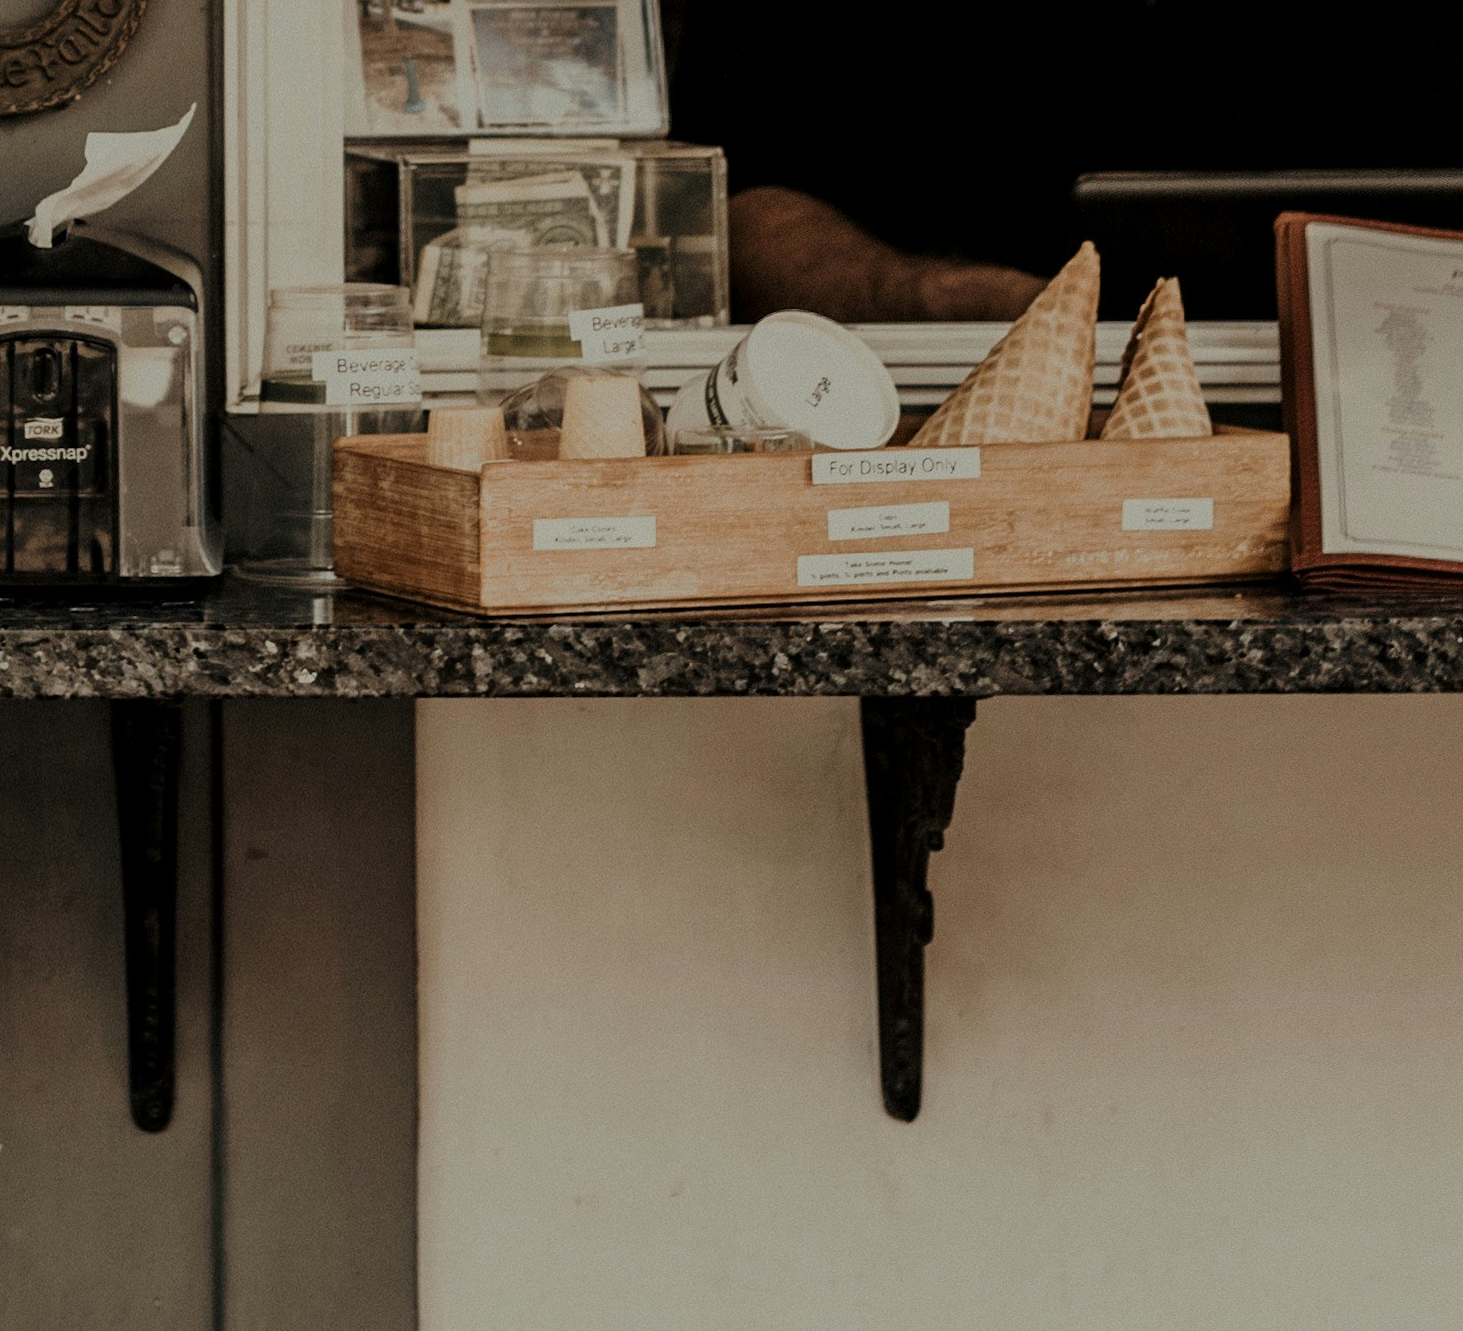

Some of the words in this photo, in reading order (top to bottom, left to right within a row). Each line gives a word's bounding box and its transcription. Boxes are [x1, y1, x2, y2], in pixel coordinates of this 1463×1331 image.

[336, 358, 406, 374] Beverage
[349, 382, 405, 400] Regular
[804, 374, 833, 408] Large
[27, 424, 61, 436] TORK
[0, 445, 91, 465] Xpressnap
[828, 460, 854, 476] For
[858, 457, 917, 478] Display
[921, 456, 958, 475] Only
